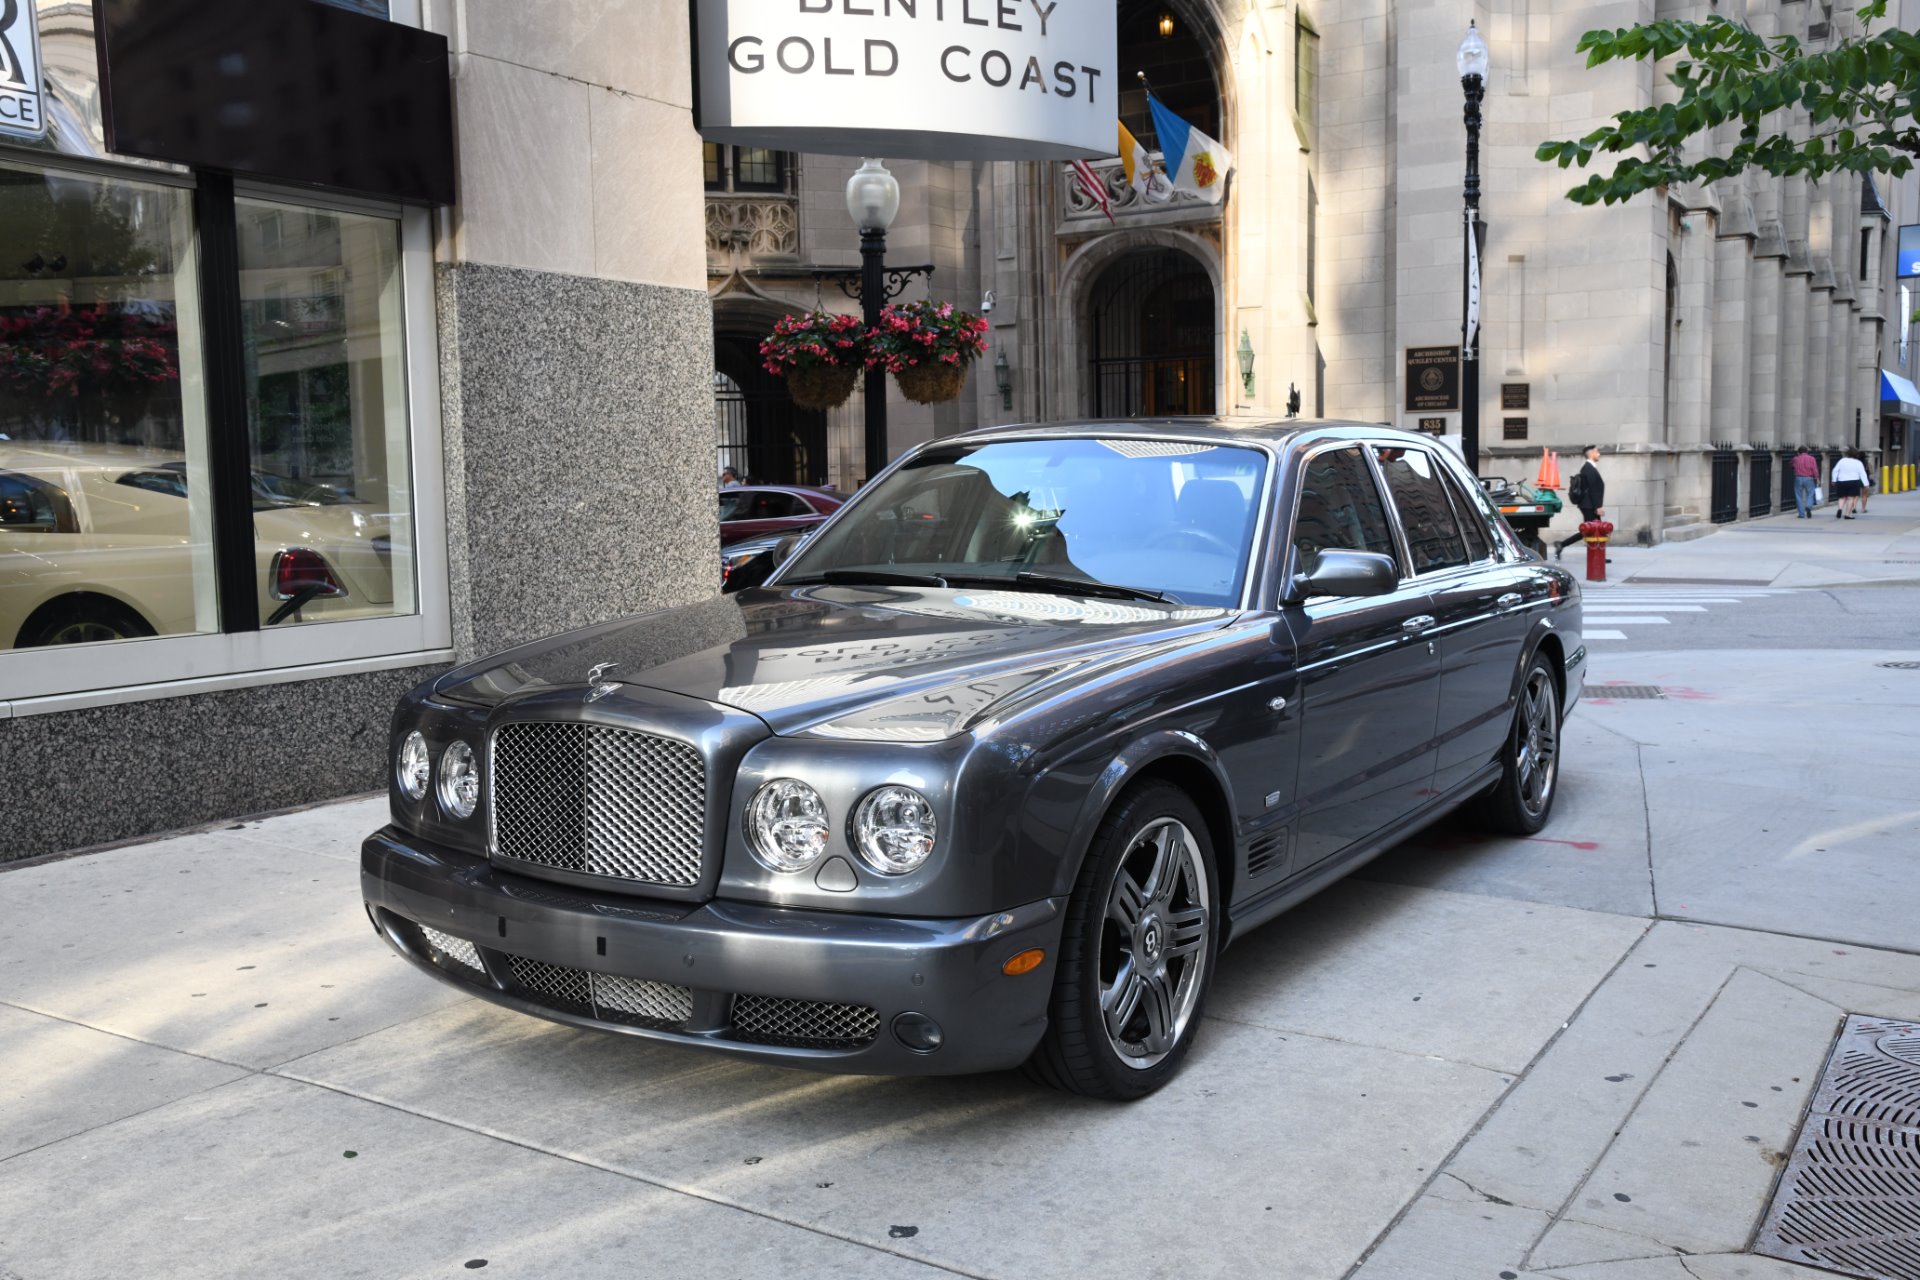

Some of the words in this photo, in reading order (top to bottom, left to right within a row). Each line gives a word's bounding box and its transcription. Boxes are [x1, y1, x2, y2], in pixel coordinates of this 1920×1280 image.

[727, 35, 899, 76] GOLD
[940, 45, 1102, 104] COAST
[1424, 419, 1441, 429] 835
